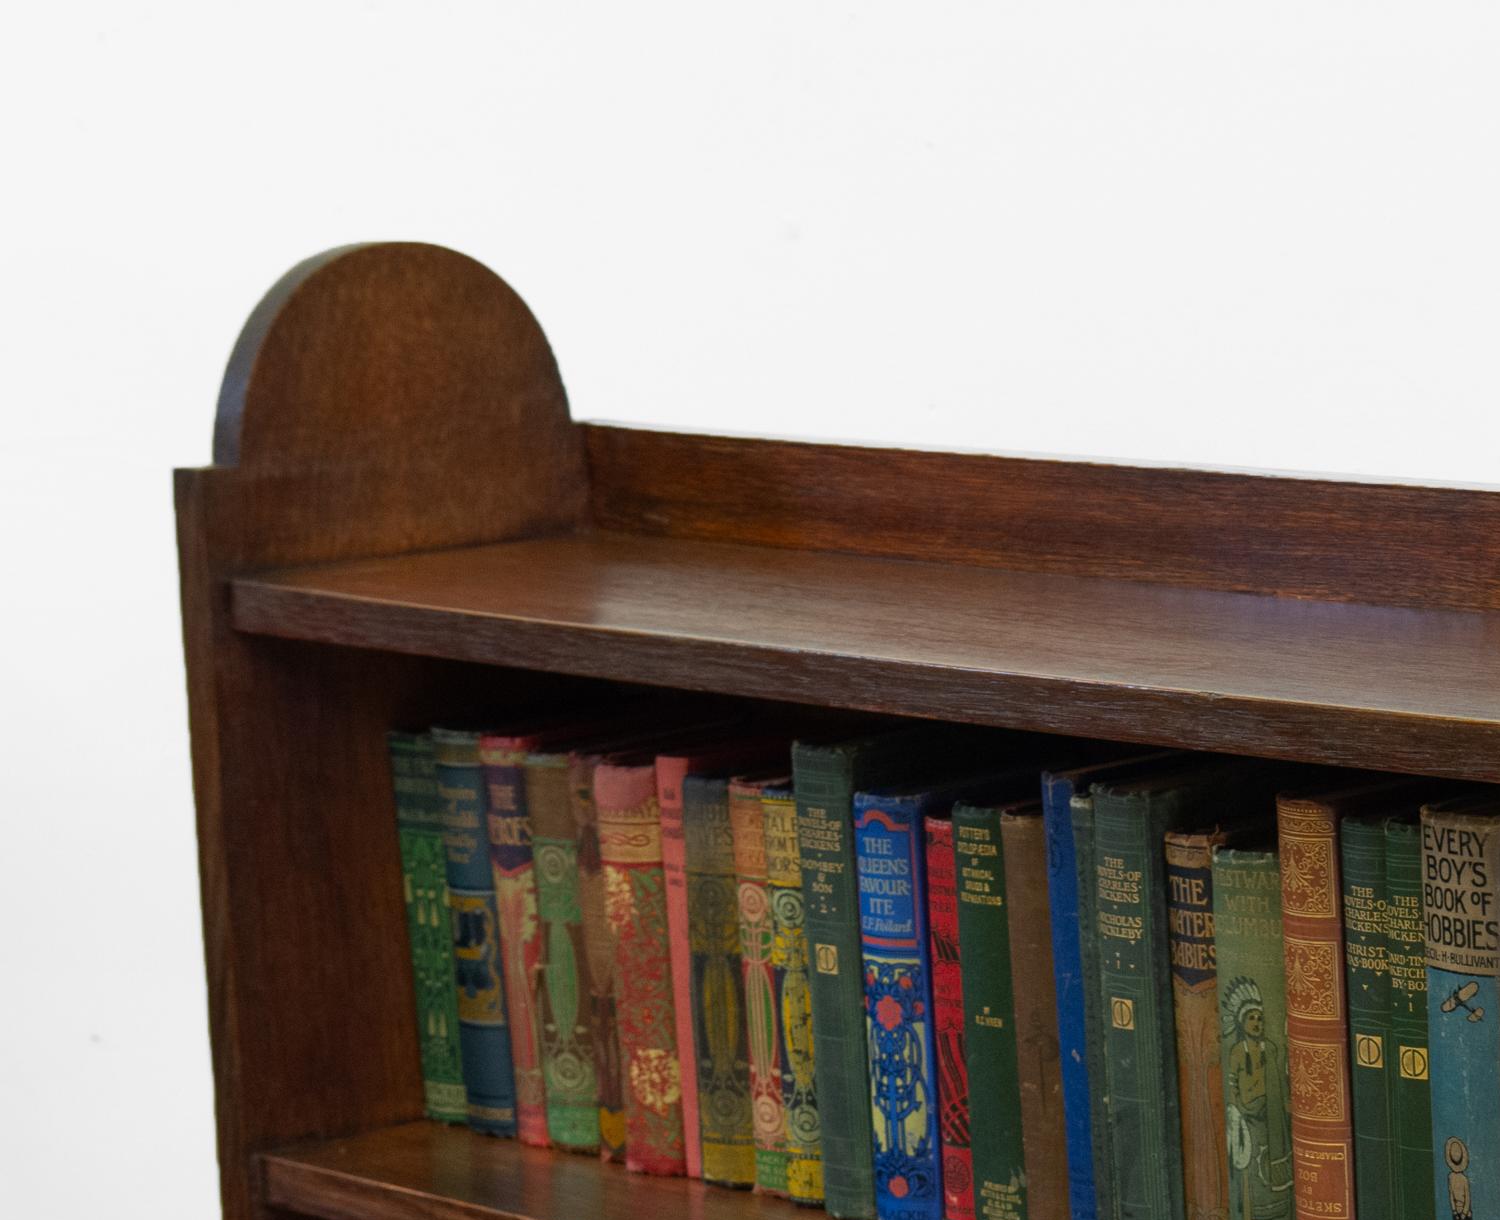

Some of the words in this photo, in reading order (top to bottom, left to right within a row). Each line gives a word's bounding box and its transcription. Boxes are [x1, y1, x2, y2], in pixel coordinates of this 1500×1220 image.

[807, 807, 826, 818] THE
[863, 836, 893, 855] THE
[1423, 824, 1490, 858] EVERY
[1104, 856, 1125, 869] THE
[1426, 854, 1488, 887] BOY'S
[1169, 875, 1208, 906] THE
[1351, 885, 1374, 898] THE
[1425, 883, 1467, 915] BOOK
[1470, 891, 1494, 916] OF
[870, 897, 895, 915] ITE
[1224, 893, 1272, 914] WITH
[1393, 895, 1419, 908] THE
[1388, 917, 1424, 931] HARLE
[1424, 911, 1500, 951] HOBBIES
[1388, 930, 1425, 942] ICKEN
